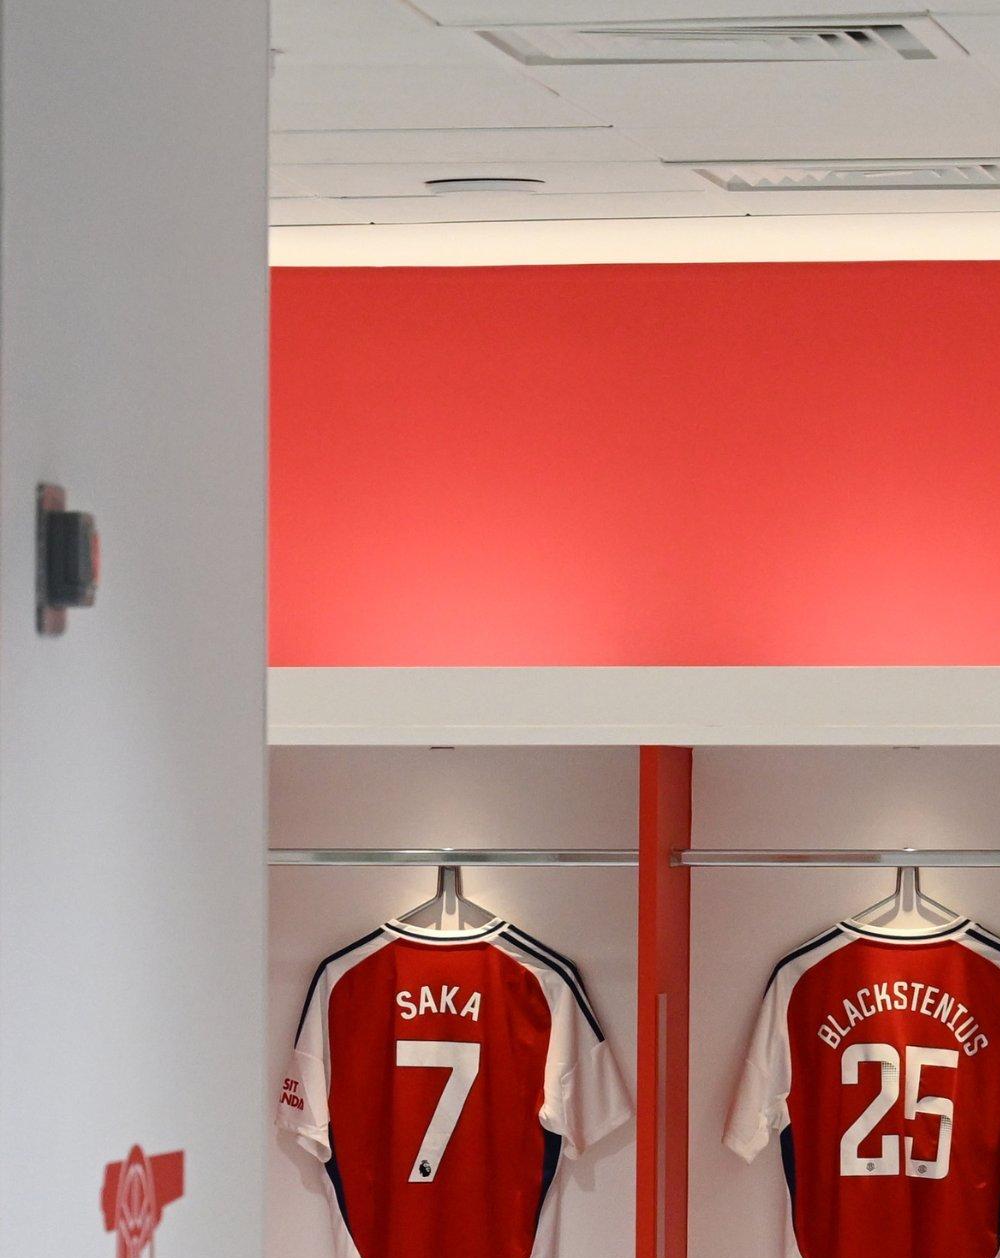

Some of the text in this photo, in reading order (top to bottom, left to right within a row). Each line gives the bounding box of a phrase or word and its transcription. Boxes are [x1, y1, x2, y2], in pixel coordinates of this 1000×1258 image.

[396, 985, 482, 1022] SAKA
[817, 981, 989, 1057] BLACKSTENIUS
[279, 1091, 304, 1111] NDA
[282, 1078, 299, 1093] SIT
[396, 1040, 481, 1183] 7
[840, 1043, 959, 1179] 25
